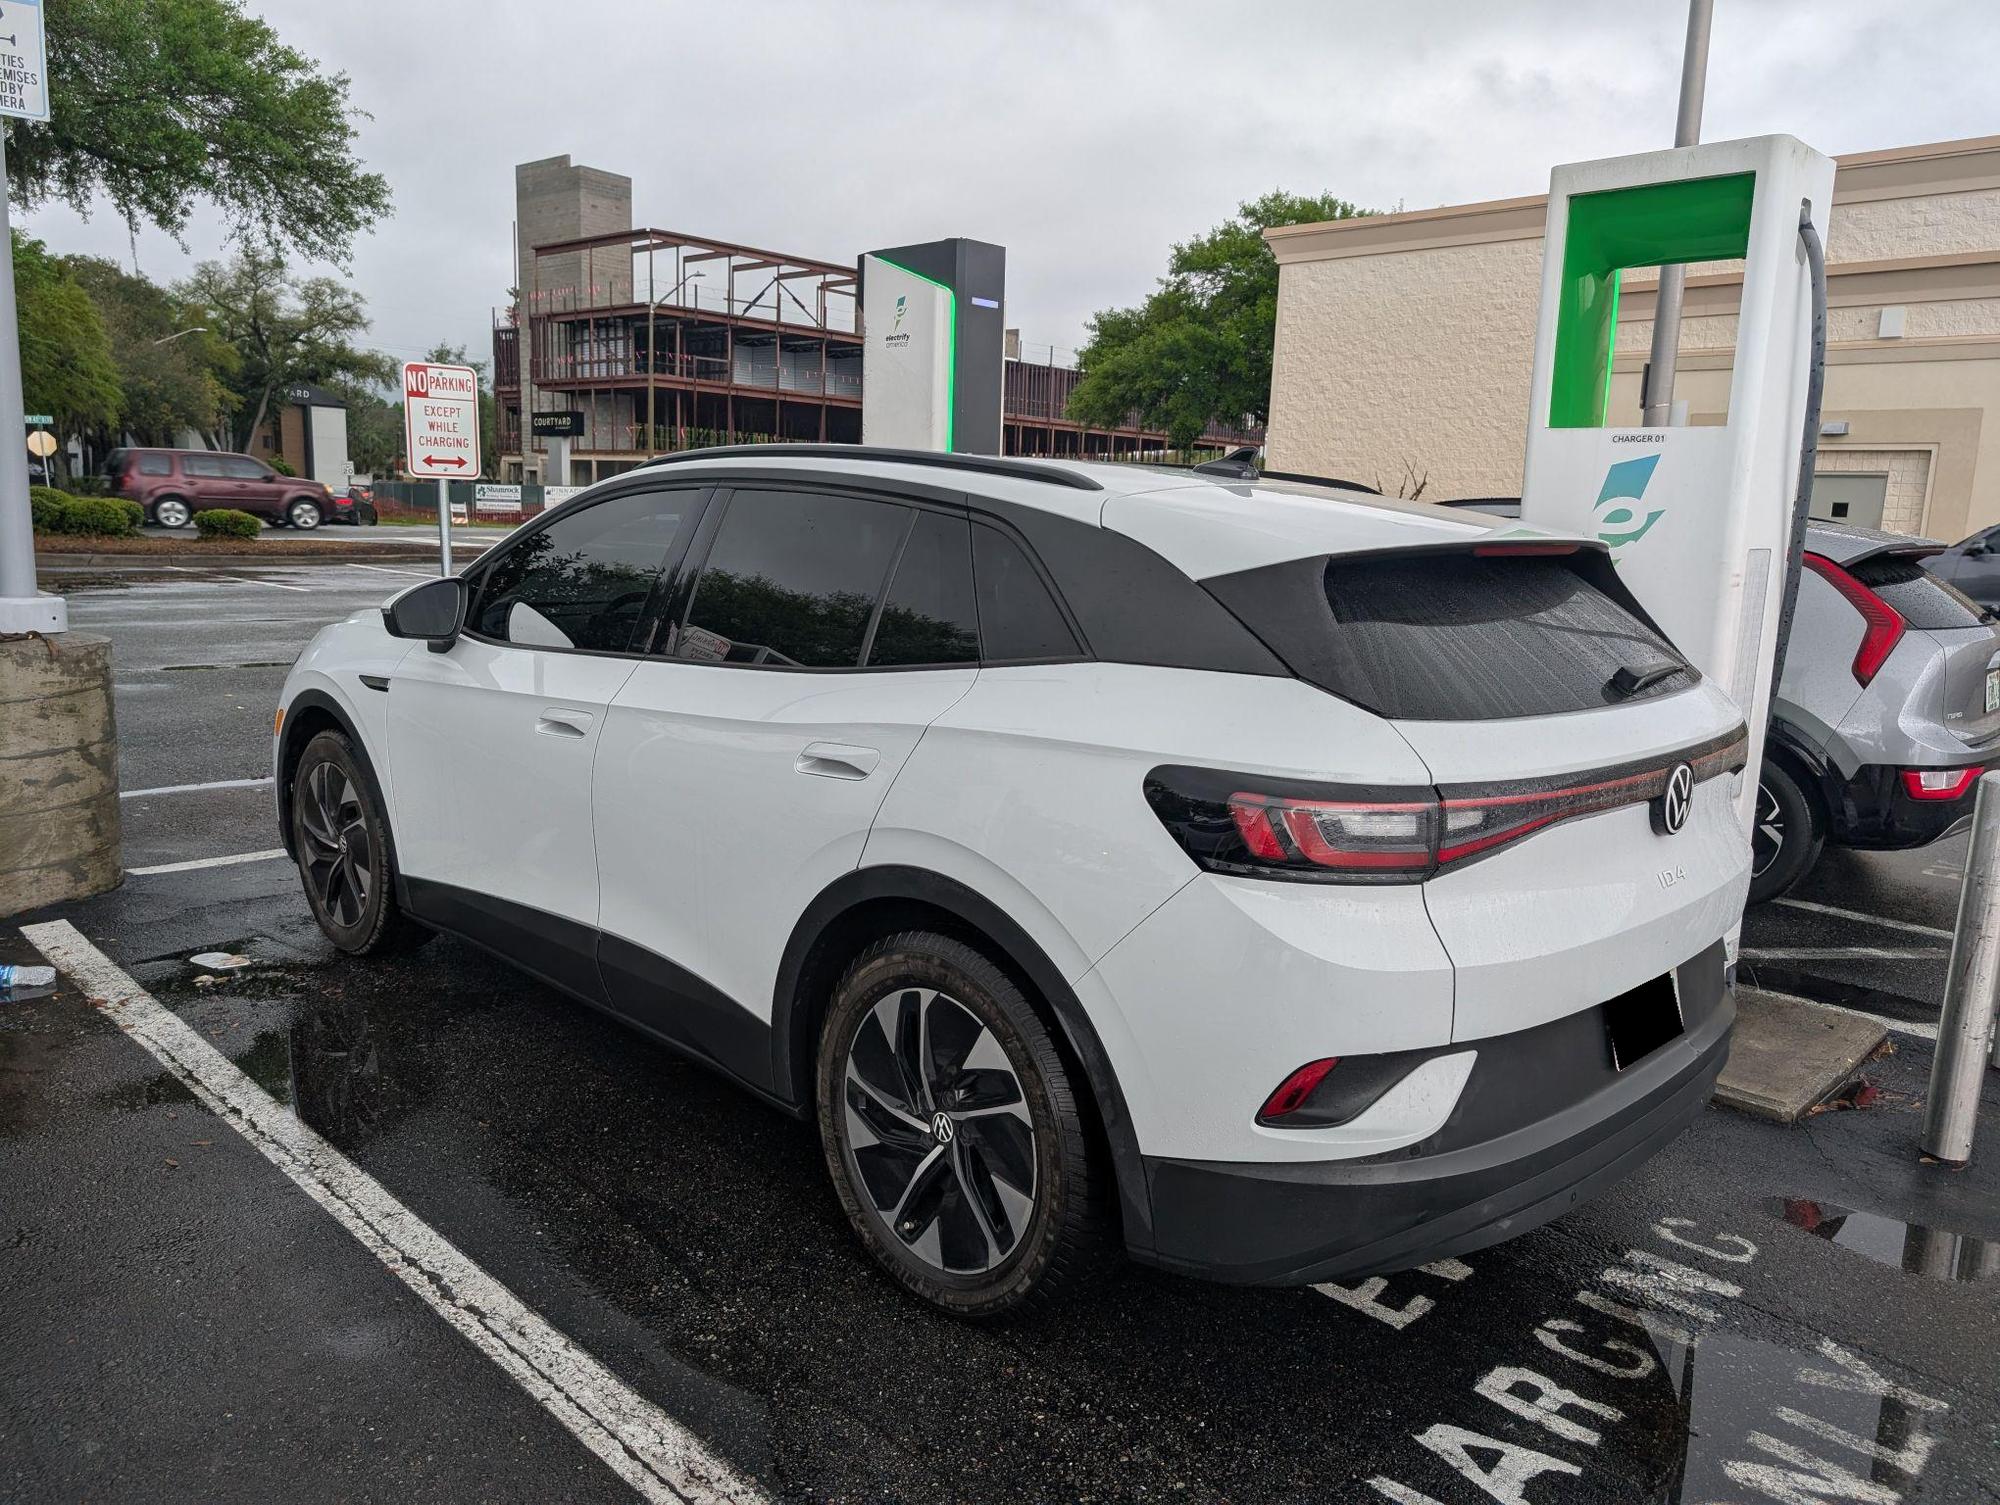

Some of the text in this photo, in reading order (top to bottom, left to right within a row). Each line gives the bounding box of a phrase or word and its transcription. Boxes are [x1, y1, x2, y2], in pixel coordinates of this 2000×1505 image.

[886, 333, 910, 341] electrify
[407, 370, 472, 393] NO PARKING
[424, 405, 462, 418] EXCEPT
[428, 421, 459, 433] WHILE
[533, 416, 572, 427] COURTYARD
[418, 435, 470, 449] CHARGING
[1612, 434, 1666, 443] CHARGER 01
[486, 486, 520, 494] Shamrock
